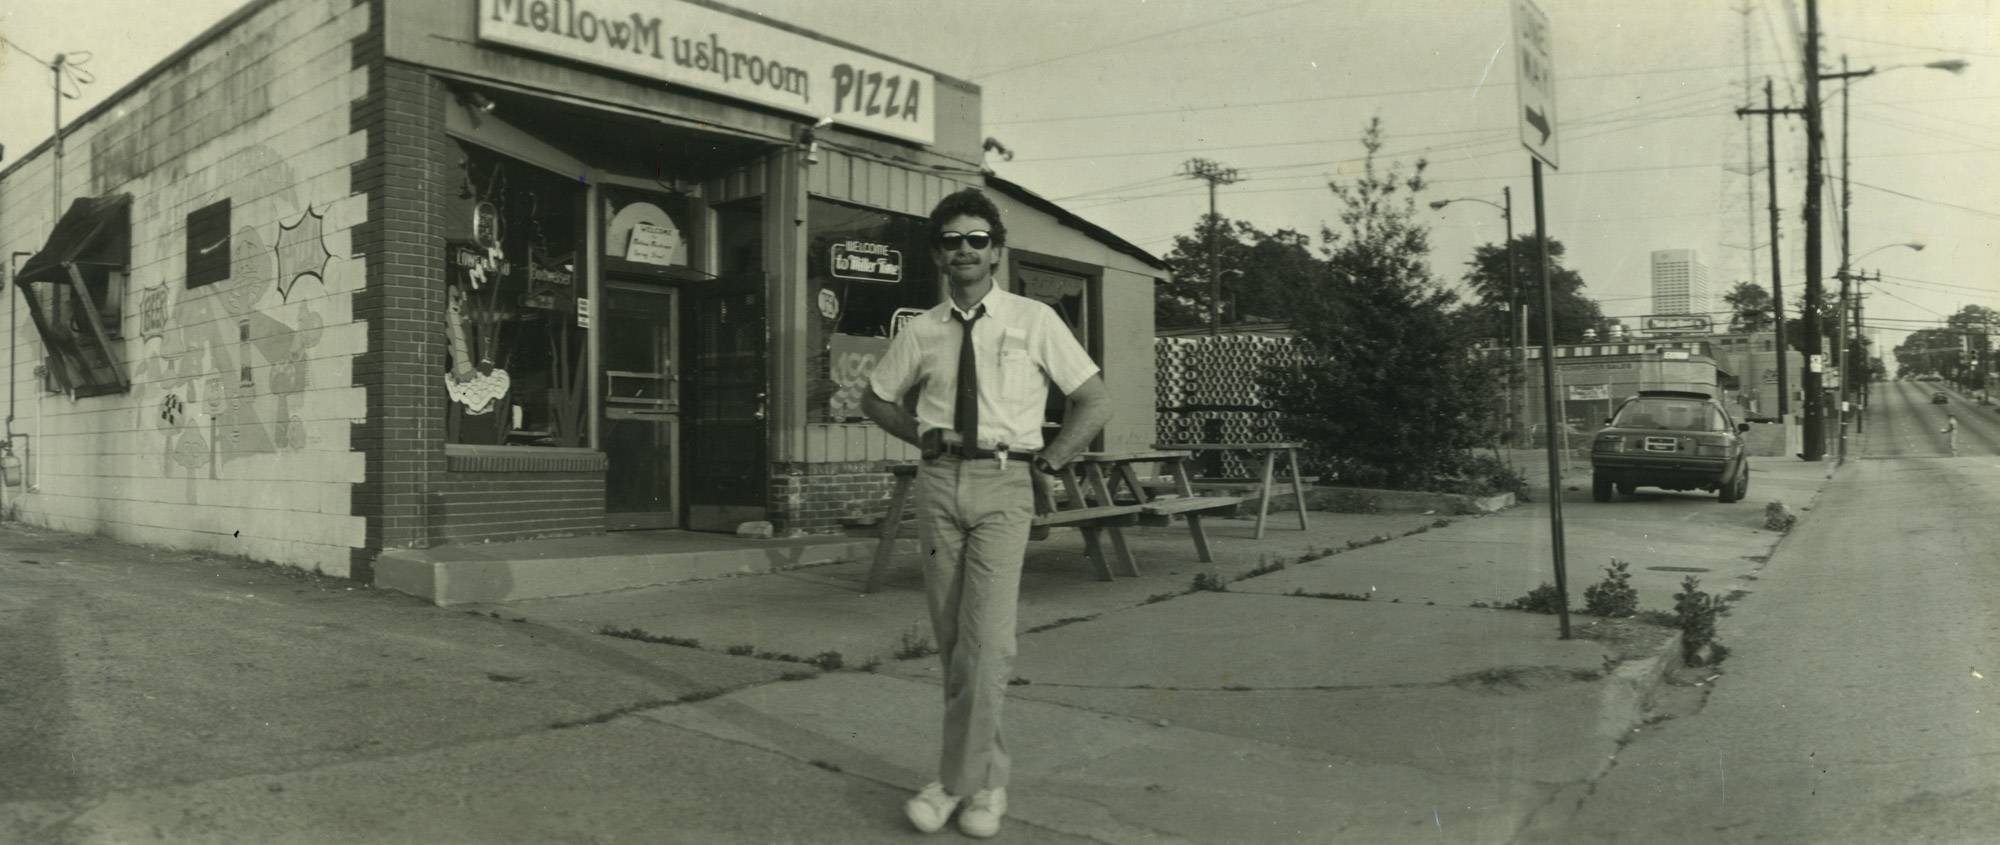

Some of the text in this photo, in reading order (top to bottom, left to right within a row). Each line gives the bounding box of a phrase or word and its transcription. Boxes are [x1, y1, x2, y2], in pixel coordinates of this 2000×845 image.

[1522, 46, 1549, 98] WAY
[831, 63, 920, 122] PIZZA
[640, 225, 672, 236] WELCOME
[845, 240, 889, 256] WELCOME
[531, 262, 572, 285] Budweiser
[836, 254, 899, 275] to Miller Time
[144, 290, 168, 333] BEER
